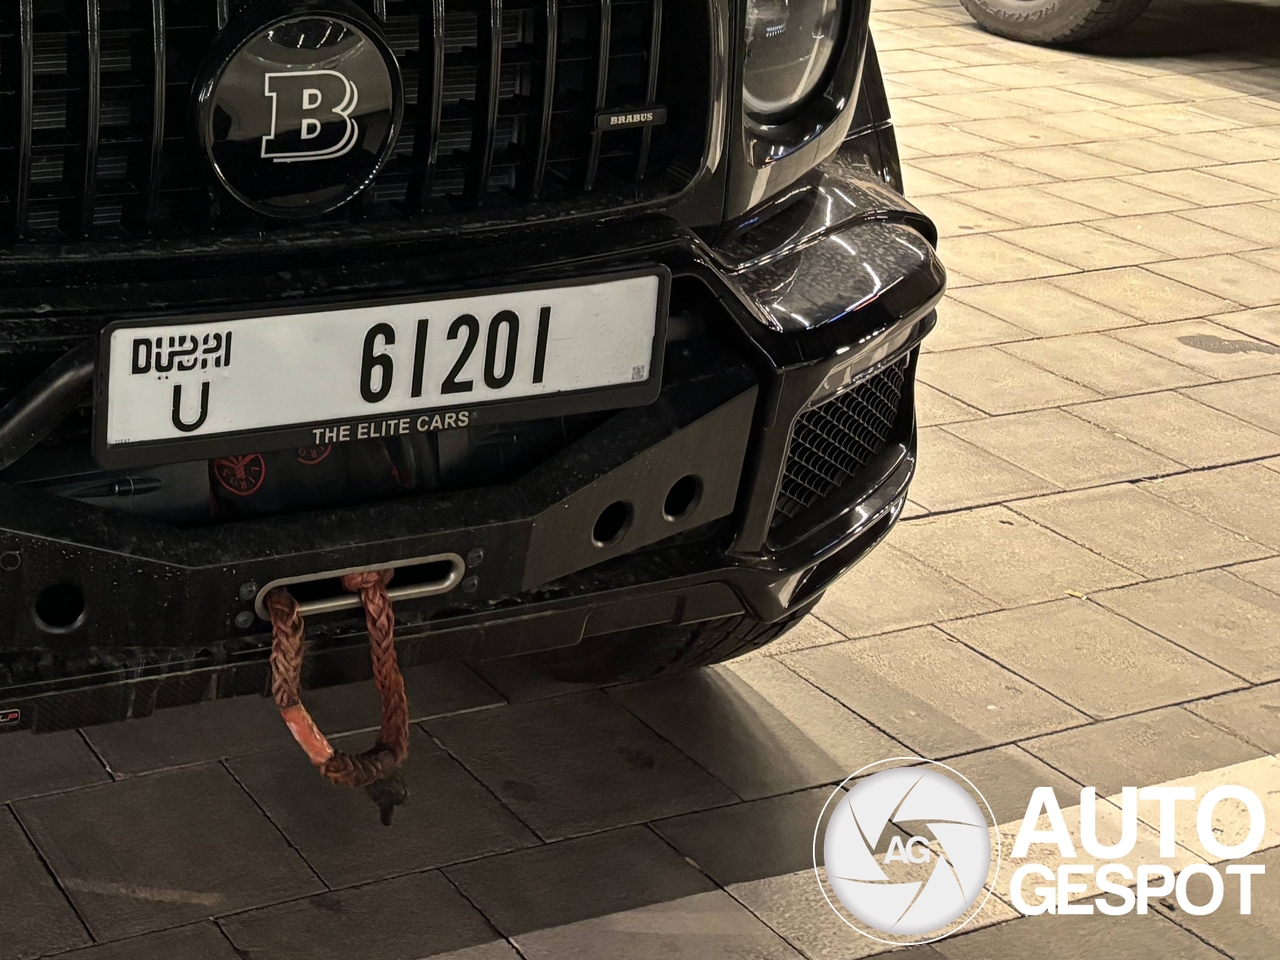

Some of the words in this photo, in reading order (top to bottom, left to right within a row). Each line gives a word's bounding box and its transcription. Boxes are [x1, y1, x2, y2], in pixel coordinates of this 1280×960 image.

[261, 70, 359, 163] B
[610, 112, 654, 125] BRABUS
[360, 306, 552, 404] 61201
[172, 381, 210, 432] U
[312, 425, 351, 444] THE
[357, 418, 411, 440] ELITE
